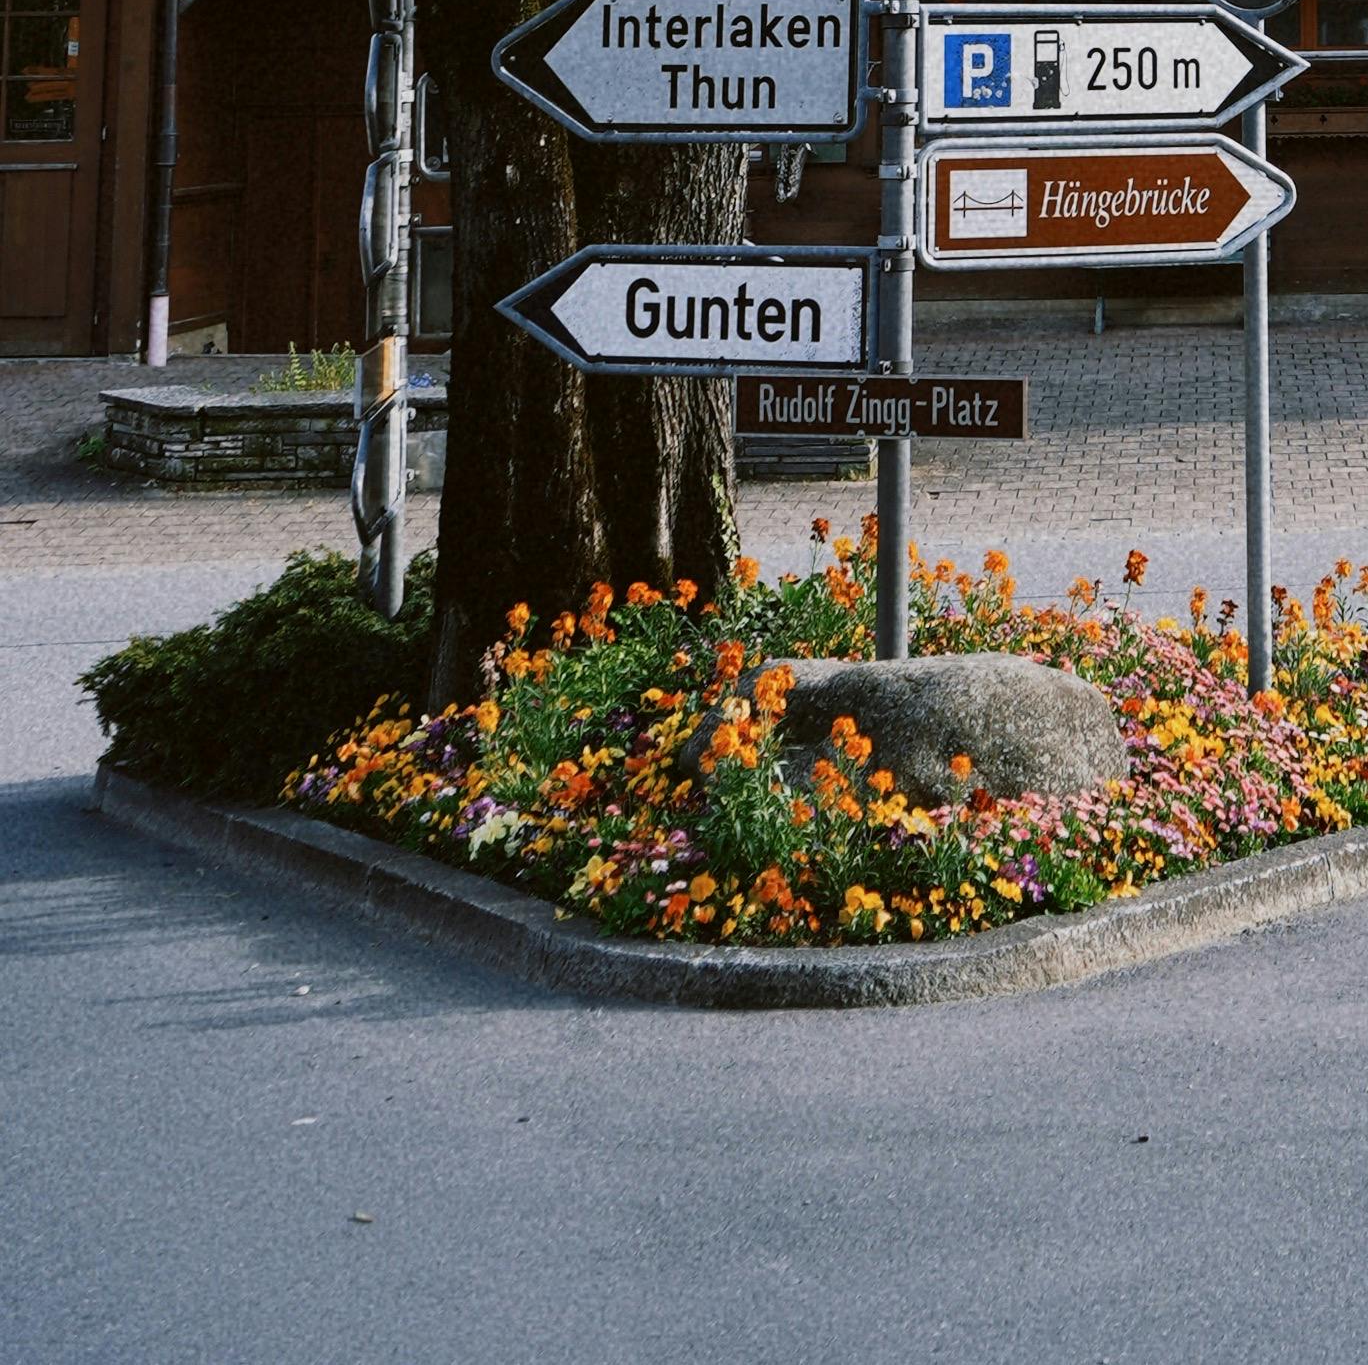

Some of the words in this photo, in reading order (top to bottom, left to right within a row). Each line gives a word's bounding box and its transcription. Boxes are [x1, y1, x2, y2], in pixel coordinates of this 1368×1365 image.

[602, 3, 842, 49] Interlaken
[661, 64, 776, 109] Thun
[962, 43, 994, 98] P
[1086, 46, 1158, 91] 250
[1173, 57, 1200, 89] m
[1038, 176, 1211, 228] Hängebrücke
[625, 277, 821, 343] Gunten
[758, 383, 835, 424] Rudolf
